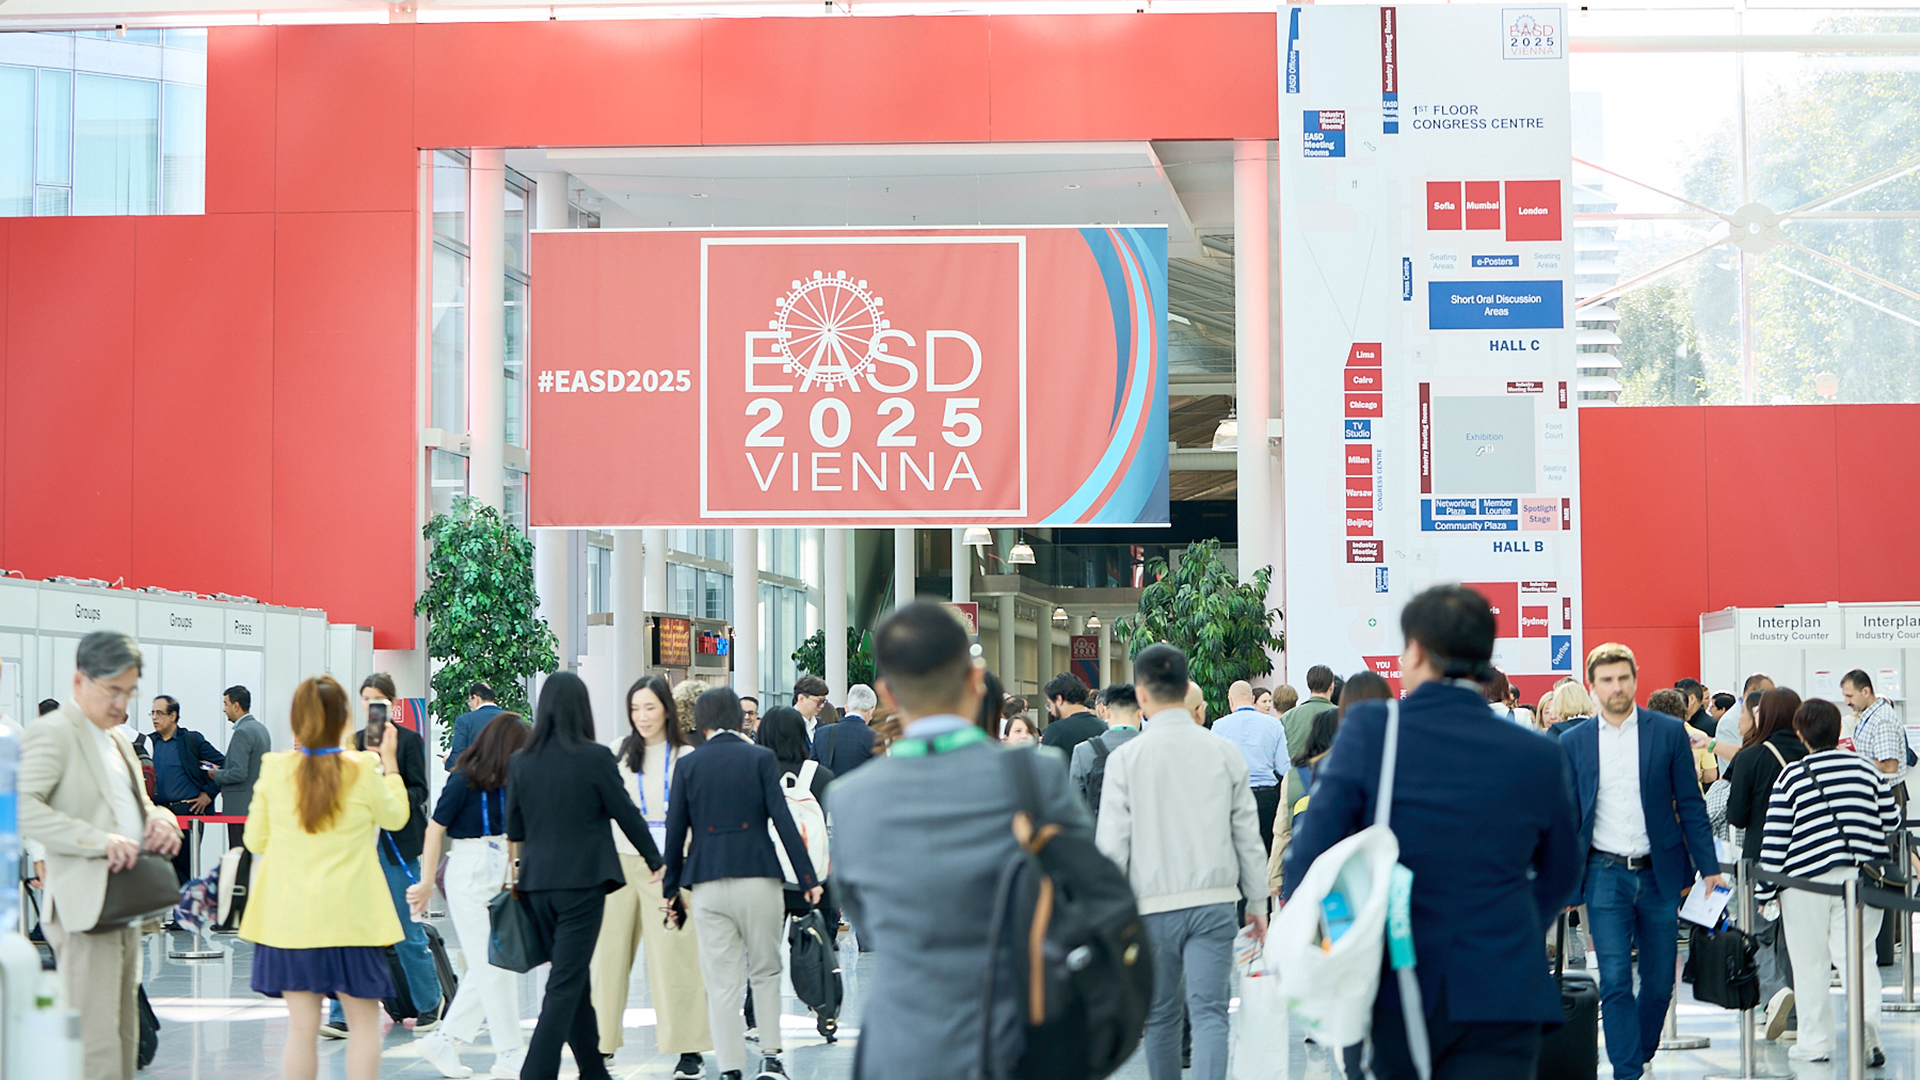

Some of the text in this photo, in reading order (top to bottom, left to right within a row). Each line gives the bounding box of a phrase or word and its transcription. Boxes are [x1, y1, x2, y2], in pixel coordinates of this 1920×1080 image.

[1510, 25, 1554, 37] EASD
[1511, 37, 1554, 47] 2025
[1385, 34, 1393, 62] Meeting
[1511, 47, 1554, 55] VIENNA
[1413, 105, 1479, 115] 1ST FLOOR
[1413, 118, 1544, 129] CONGRESS CENTRE
[1304, 141, 1334, 150] Meeting
[1434, 202, 1455, 210] Sofia
[1466, 201, 1498, 209] Mumbai
[1518, 207, 1548, 215] London
[1430, 253, 1457, 262] Seating
[1534, 252, 1561, 261] Seating
[1433, 262, 1454, 270] Areas
[1477, 258, 1513, 266] e-Posters
[1537, 261, 1558, 269] Areas
[1450, 294, 1542, 304] Short Oral Discussion
[1484, 307, 1509, 316] Areas
[1490, 340, 1540, 351] HALL C
[1356, 351, 1374, 359] Lima
[744, 329, 983, 393] EASD
[538, 369, 692, 394] #EASD2025
[1353, 376, 1373, 384] Cairo
[1349, 401, 1378, 410] Chicago
[744, 397, 983, 448] 2025
[1352, 422, 1363, 430] TV
[1345, 430, 1370, 438] Studio
[1466, 433, 1504, 441] Exhibition
[1348, 456, 1370, 464] Milan
[745, 452, 983, 491] VIENNA
[1543, 465, 1567, 473] Seating
[1346, 489, 1372, 497] Warsaw
[1436, 499, 1477, 509] Networking
[1484, 499, 1512, 507] Member
[1486, 507, 1511, 516] Lounge
[1523, 505, 1557, 514] Spotlight
[1347, 519, 1373, 528] Beijing
[1529, 515, 1551, 523] Stage
[1435, 521, 1507, 531] Community Plaza
[1493, 541, 1544, 553] HALL B
[75, 603, 101, 623] Groups
[170, 613, 192, 630] Groups
[1522, 617, 1548, 627] Sydney
[1758, 617, 1821, 630] Interplan
[234, 620, 252, 635] Press
[1750, 631, 1829, 642] Industry Counter
[1856, 631, 1894, 640] Industry
[1552, 641, 1570, 665] Overflow
[1376, 661, 1390, 669] YOU
